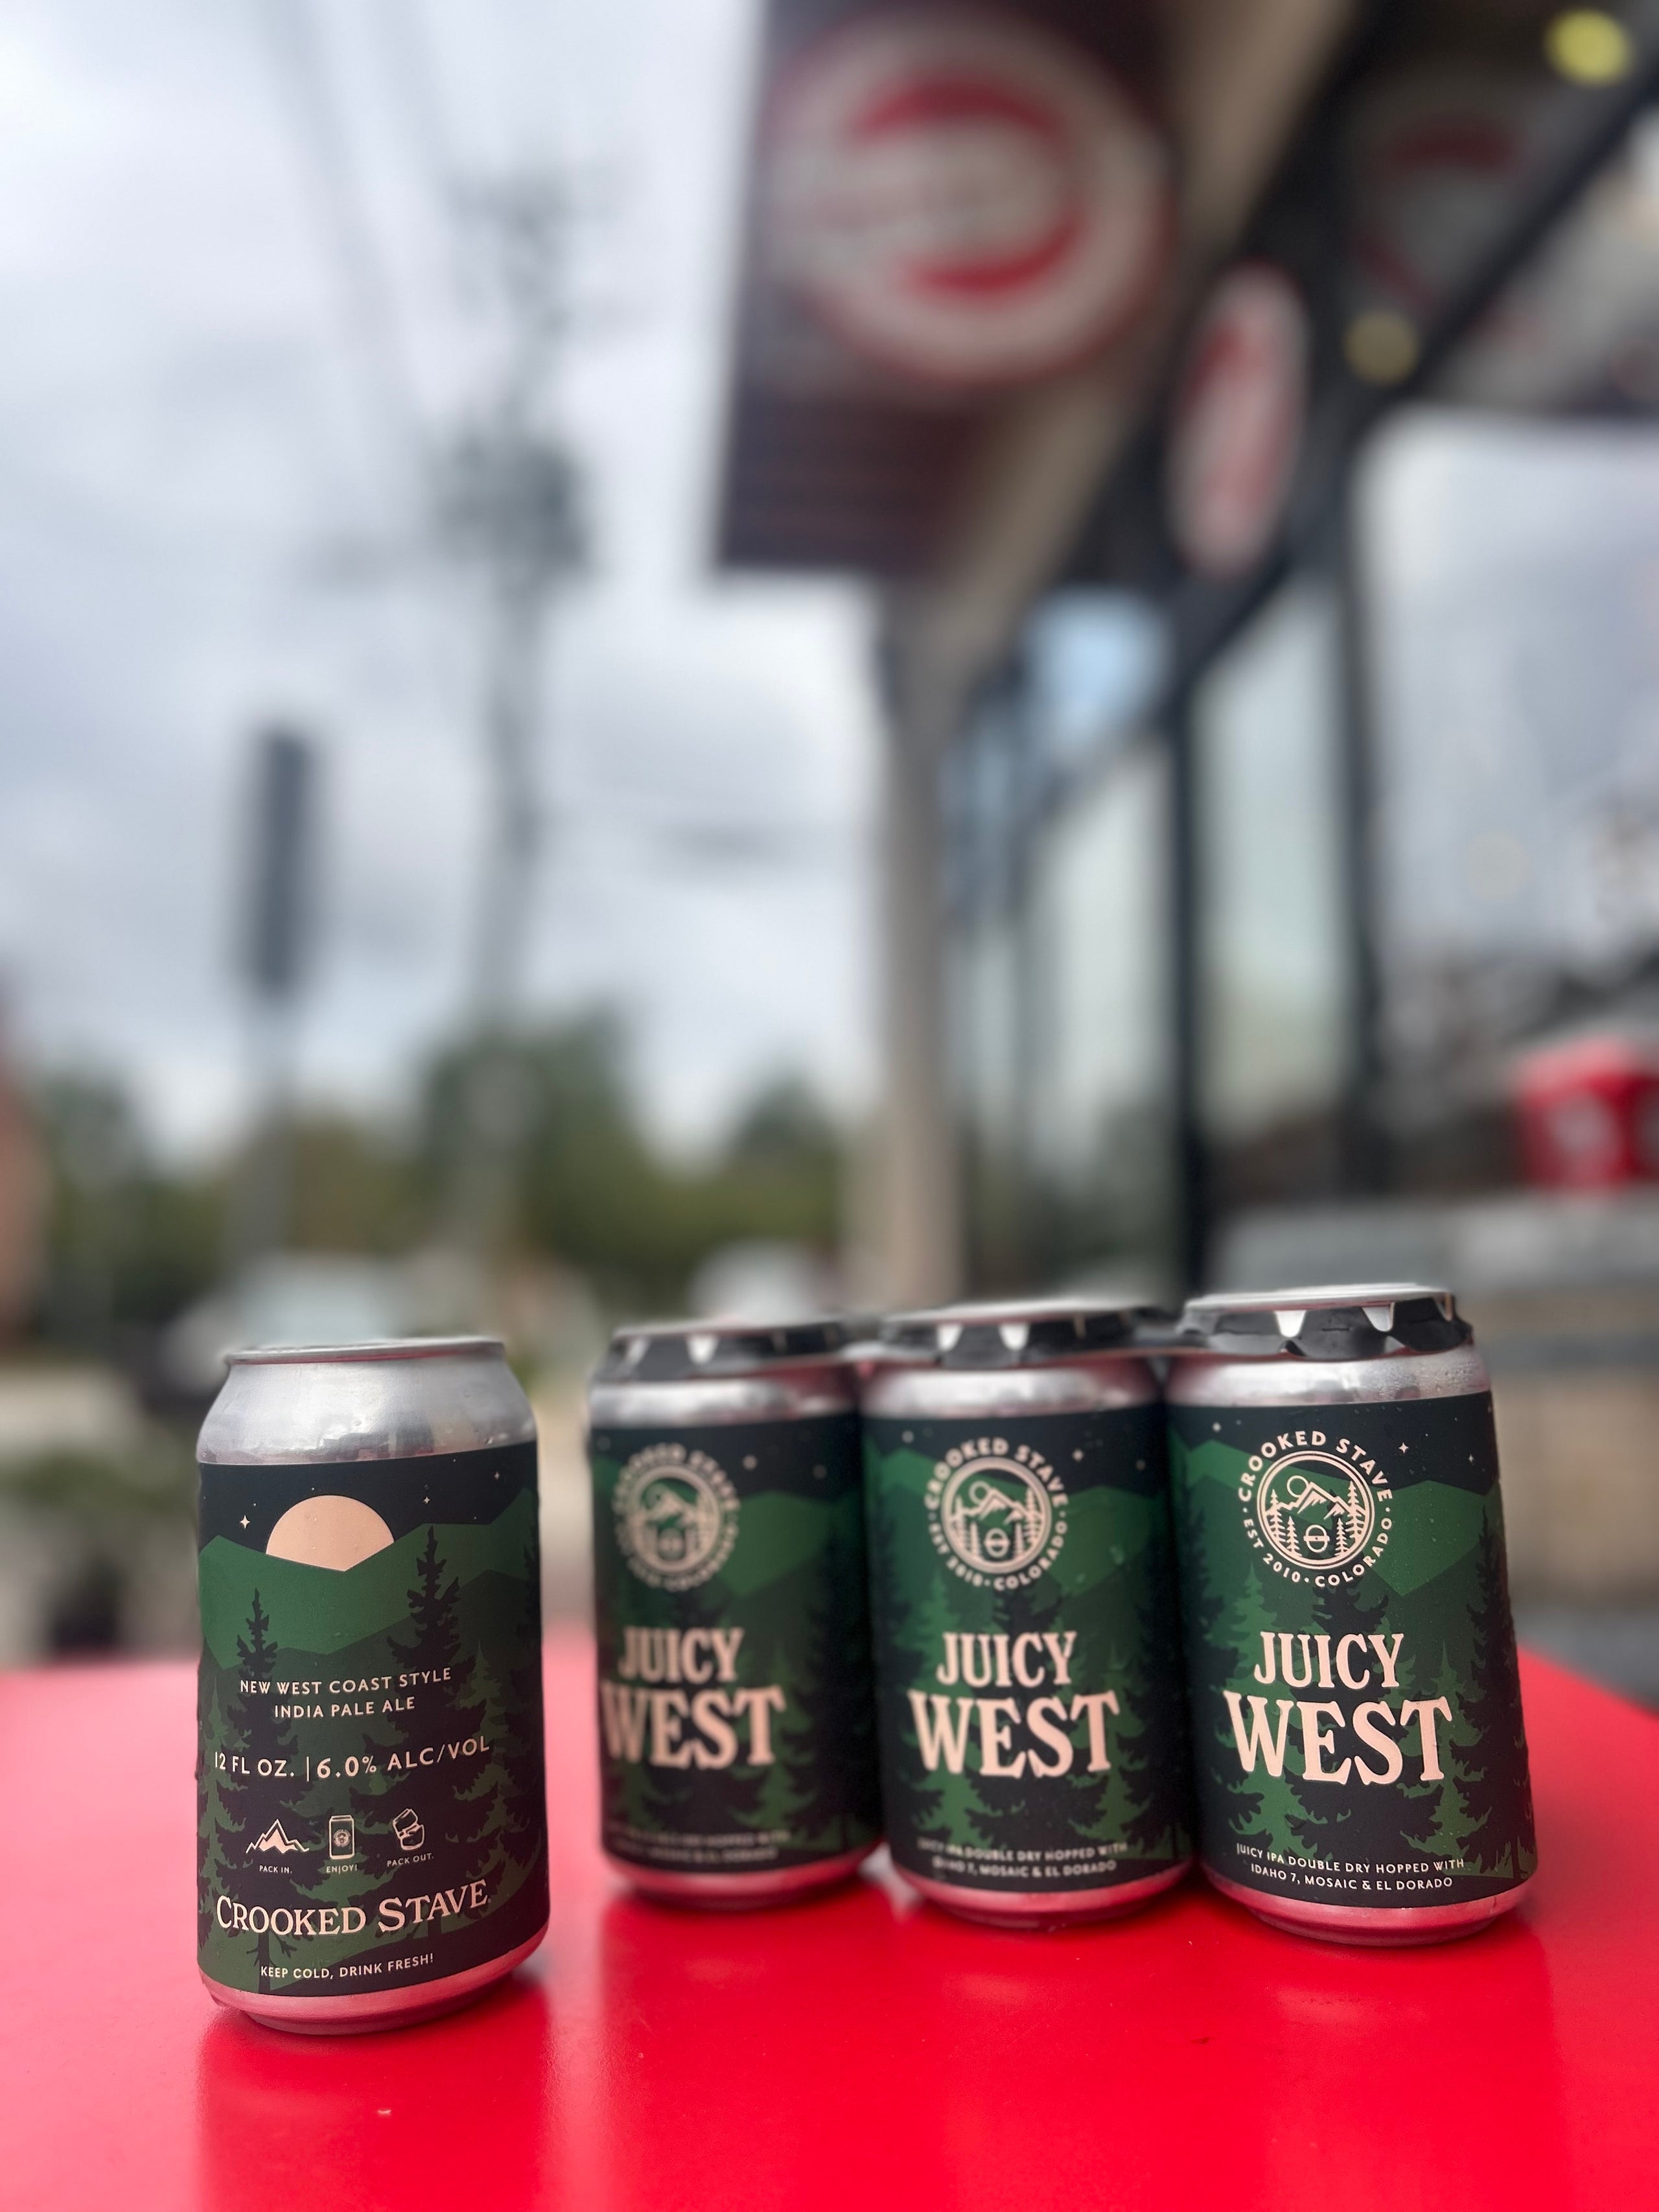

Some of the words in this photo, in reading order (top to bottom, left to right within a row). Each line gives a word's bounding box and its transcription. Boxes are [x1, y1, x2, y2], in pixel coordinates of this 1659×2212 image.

[924, 1437, 1009, 1511] CROOKED
[1014, 1444, 1069, 1507] STAVE
[1238, 1430, 1327, 1502] CROOKED
[1336, 1438, 1393, 1502] STAVE
[993, 1520, 1069, 1591] COLORADO
[1244, 1518, 1264, 1548] EST
[1262, 1553, 1300, 1583] 2010
[1315, 1517, 1392, 1588] COLORADO
[618, 1627, 743, 1683] JUICY
[936, 1631, 1077, 1687] JUICY
[1254, 1631, 1404, 1690] JUICY
[240, 1679, 270, 1694] NEW
[277, 1681, 321, 1695] WEST
[329, 1676, 391, 1694] COAST
[399, 1667, 452, 1688] STYLE
[274, 1701, 324, 1718] INDIA
[331, 1701, 375, 1717] PALE
[382, 1696, 415, 1712] ALE
[601, 1681, 786, 1769] WEST
[214, 1751, 227, 1771] 12
[231, 1756, 251, 1775] FL
[387, 1735, 490, 1771] ALC/VOL
[907, 1689, 1120, 1779] WEST
[1223, 1690, 1452, 1786] WEST
[259, 1864, 278, 1874] PACK
[326, 1863, 358, 1874] ENJOY!
[386, 1856, 410, 1867] PACK
[979, 1864, 1029, 1878] MOSAIC
[1032, 1865, 1041, 1878] &
[1045, 1865, 1060, 1876] EL
[1063, 1859, 1117, 1876] DORADO
[1016, 1849, 1041, 1861] DRY
[1044, 1846, 1096, 1861] HOPPED
[1098, 1842, 1128, 1856] WITH
[1236, 1843, 1263, 1859] JUICY
[1267, 1851, 1284, 1865] IPA
[1288, 1856, 1340, 1872] DOUBLE
[1345, 1863, 1370, 1873] DRY
[1376, 1863, 1429, 1873] HOPPED
[1433, 1858, 1464, 1870] WITH
[1251, 1863, 1286, 1881] IDAHO
[1291, 1873, 1301, 1884] 7,
[1305, 1876, 1358, 1890] MOSAIC
[1362, 1880, 1371, 1891] &
[1376, 1881, 1392, 1891] EL
[1396, 1877, 1452, 1891] DORADO
[216, 1895, 367, 1936] CROOKED
[378, 1879, 488, 1933] STAVE
[260, 1964, 289, 1979] KEEP
[293, 1965, 334, 1979] COLD,
[339, 1962, 382, 1977] DRINK
[388, 1953, 434, 1972] FRESH!
